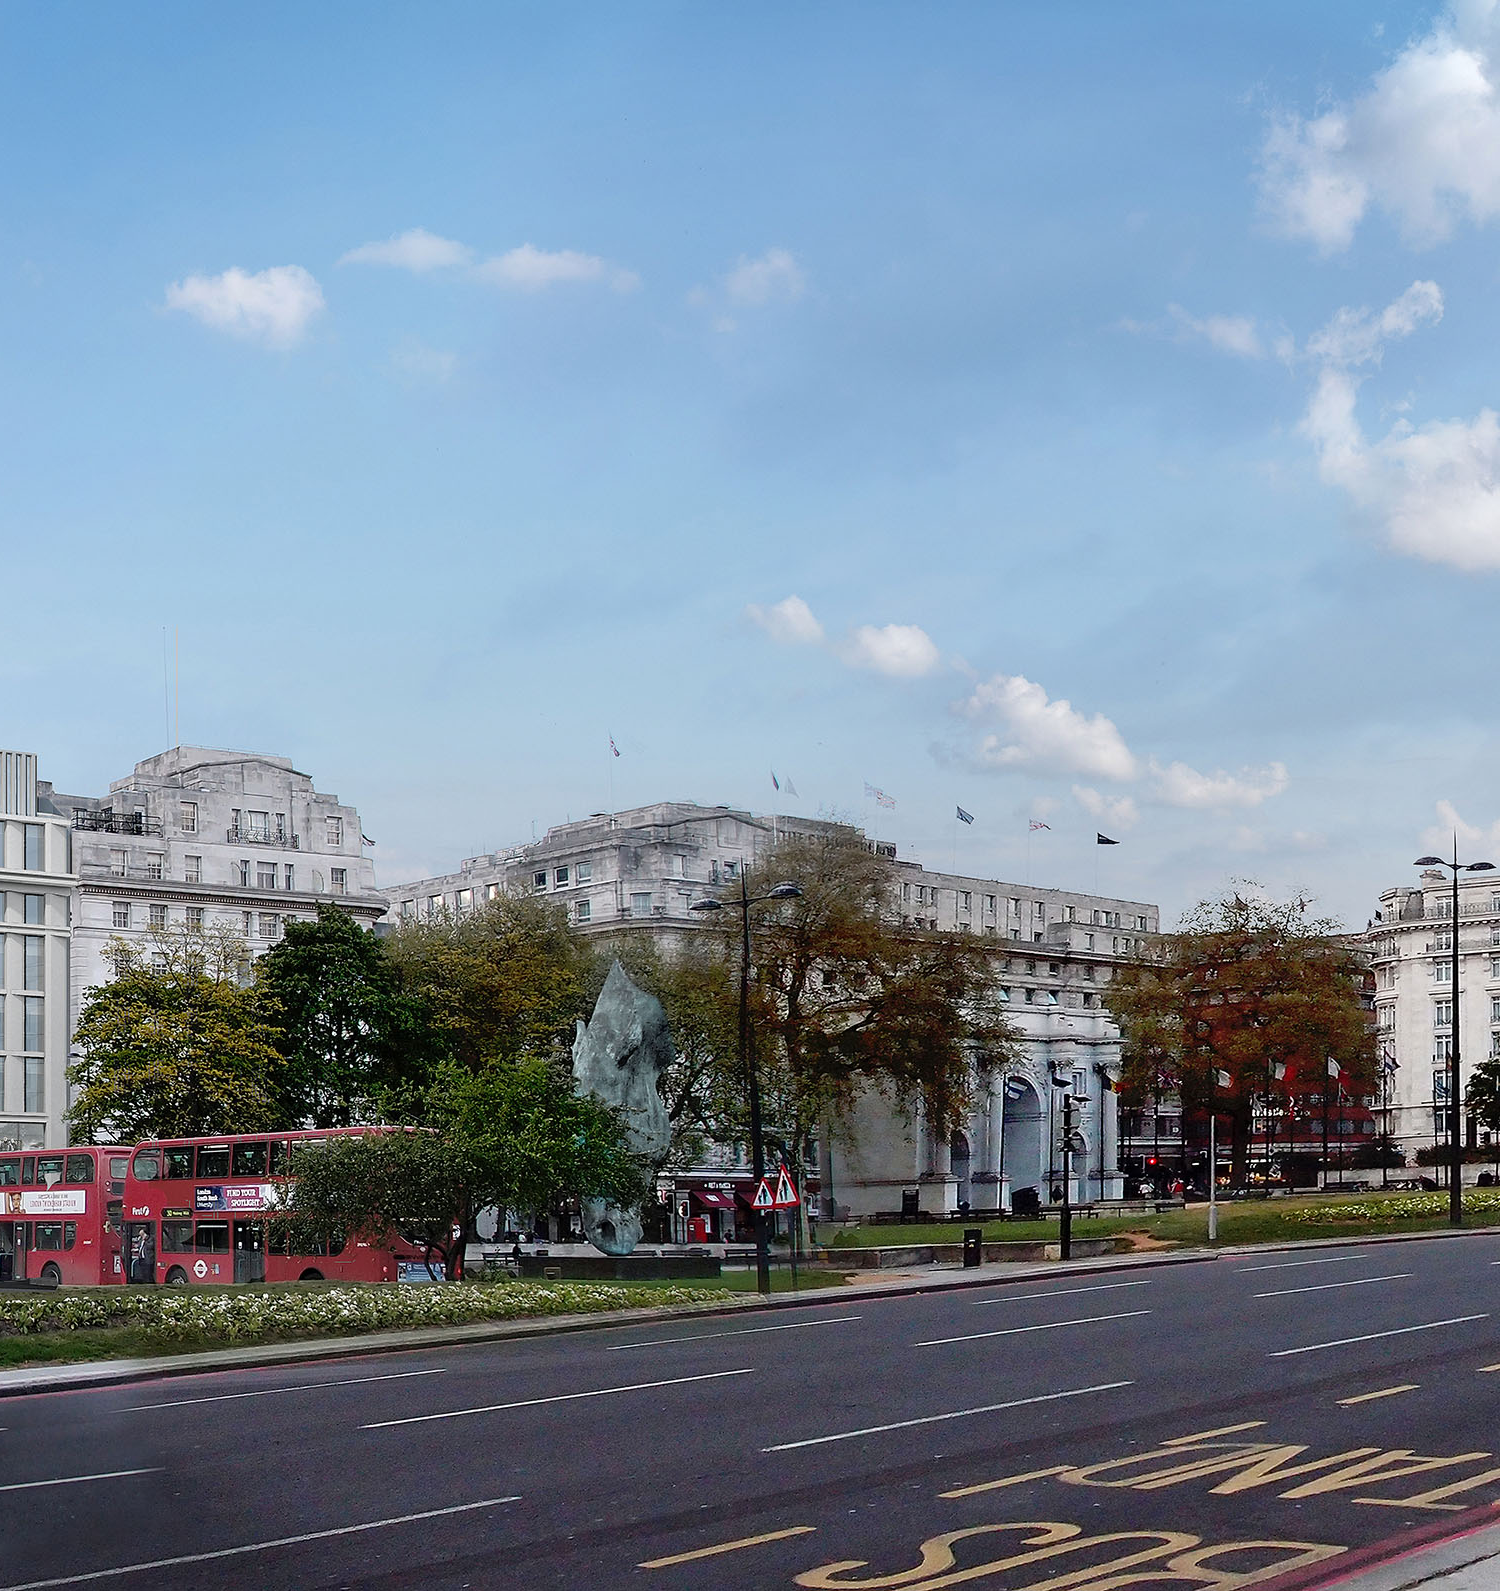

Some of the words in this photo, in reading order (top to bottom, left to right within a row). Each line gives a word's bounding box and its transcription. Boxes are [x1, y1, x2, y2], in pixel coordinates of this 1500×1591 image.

[226, 1189, 241, 1197] FIND
[241, 1188, 257, 1197] YOUR
[230, 1199, 261, 1207] SPOTLIGHT
[793, 1521, 1348, 1591] BUS
